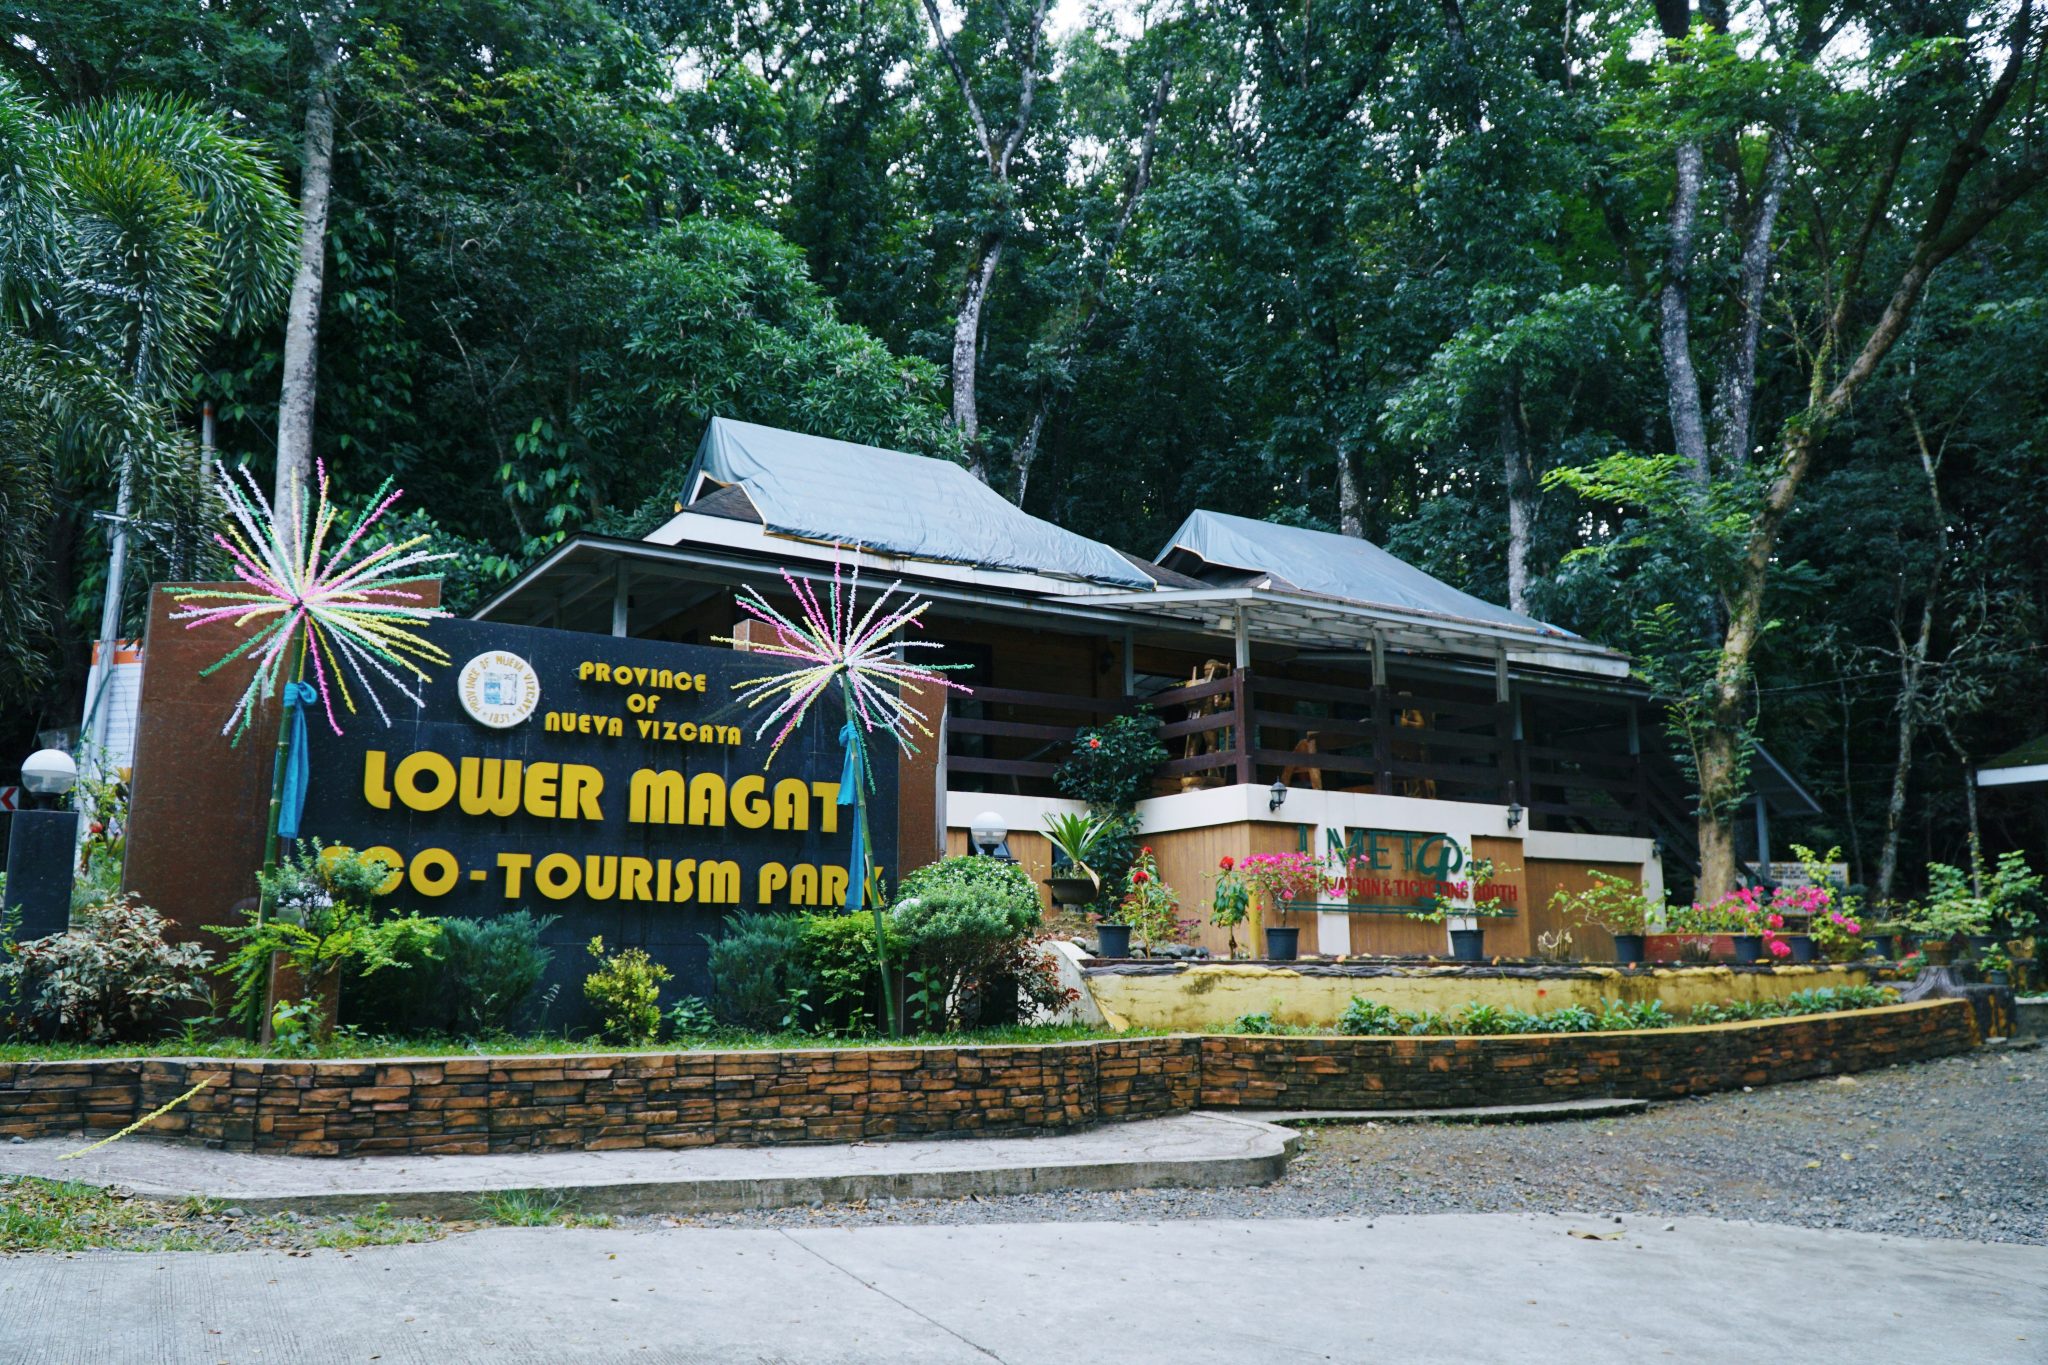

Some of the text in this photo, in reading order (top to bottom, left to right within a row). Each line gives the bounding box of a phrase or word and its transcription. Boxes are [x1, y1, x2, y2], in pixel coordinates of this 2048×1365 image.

[465, 655, 536, 715] PROVINCE OF NUEVA VIZCAYA
[578, 661, 707, 693] PROVINCE
[627, 693, 661, 714] OF
[545, 711, 741, 747] NUEVA VIZCAYA
[364, 750, 841, 833] LOWER MAGAT
[497, 852, 741, 904] TOURISM
